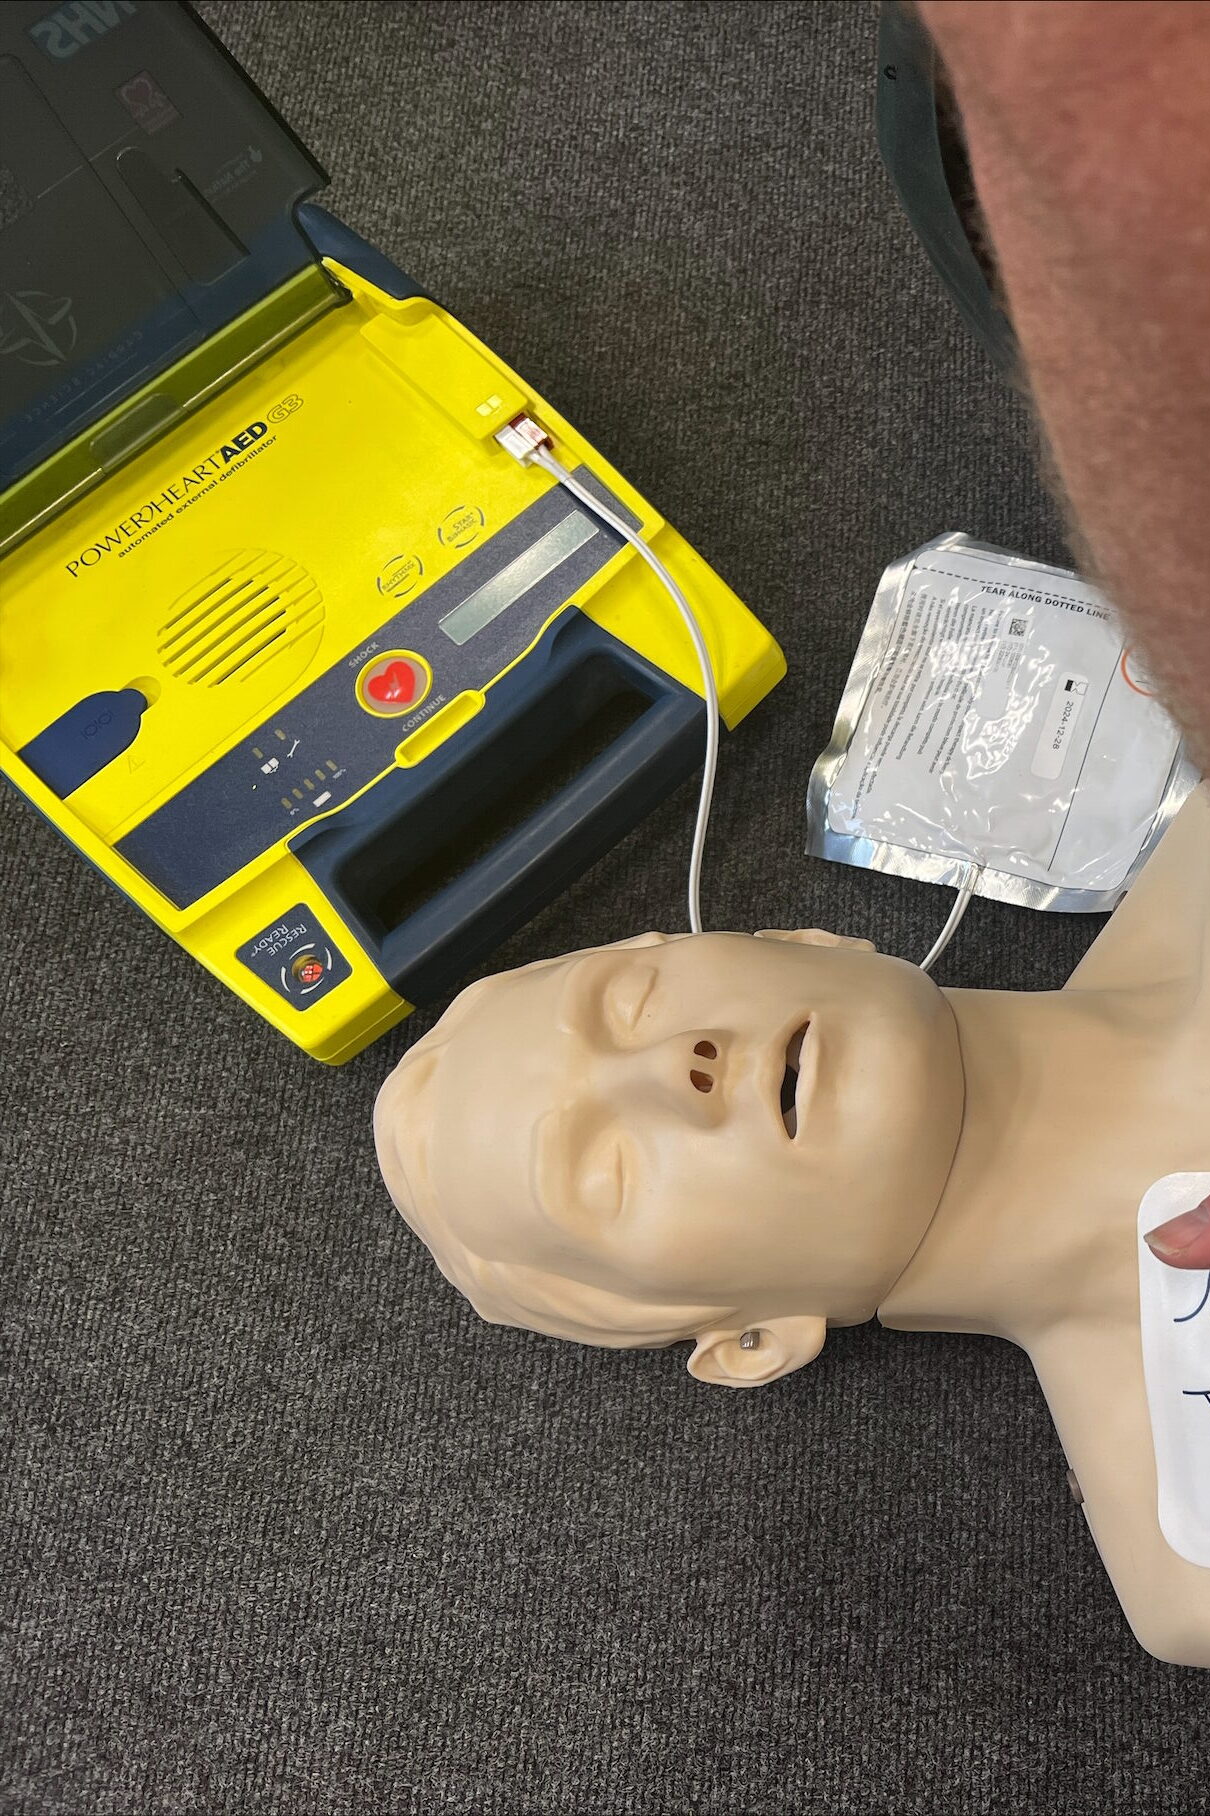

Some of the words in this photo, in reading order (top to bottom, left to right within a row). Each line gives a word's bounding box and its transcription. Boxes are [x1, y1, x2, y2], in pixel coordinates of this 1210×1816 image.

[266, 393, 304, 424] G3
[118, 513, 174, 558] automated
[176, 480, 218, 514] external
[219, 435, 278, 482] defibrillator
[981, 585, 1006, 597] TEAR
[1008, 590, 1042, 603] ALONG
[1045, 597, 1084, 613] DOTTED
[1086, 608, 1112, 621] LINE
[348, 641, 380, 669] SHOCK
[402, 693, 447, 732] CONTINUE
[267, 923, 307, 956] RESCUE
